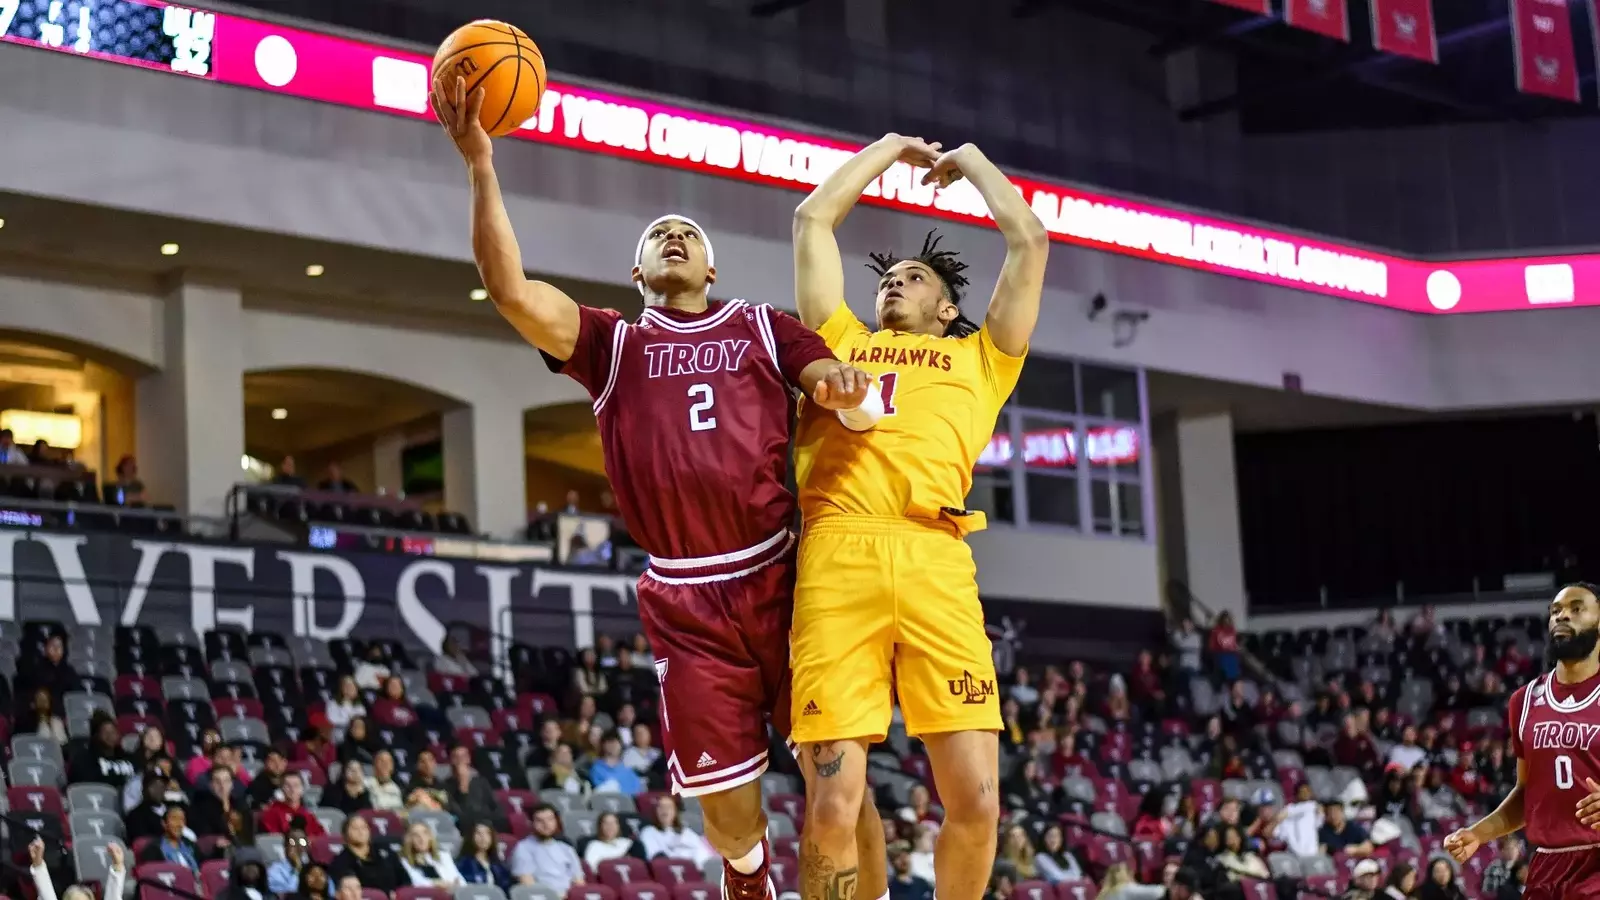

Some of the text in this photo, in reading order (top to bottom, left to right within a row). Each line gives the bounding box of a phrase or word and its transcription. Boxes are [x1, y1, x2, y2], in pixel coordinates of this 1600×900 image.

[562, 95, 649, 152] YOUR
[650, 114, 741, 169] COVID
[742, 131, 855, 186] VACCIN
[644, 339, 751, 379] TROY
[687, 383, 717, 431] 2
[947, 669, 995, 705] ULM
[1533, 720, 1600, 752] TROY
[696, 759, 718, 769] adidas
[1555, 754, 1574, 790] 0
